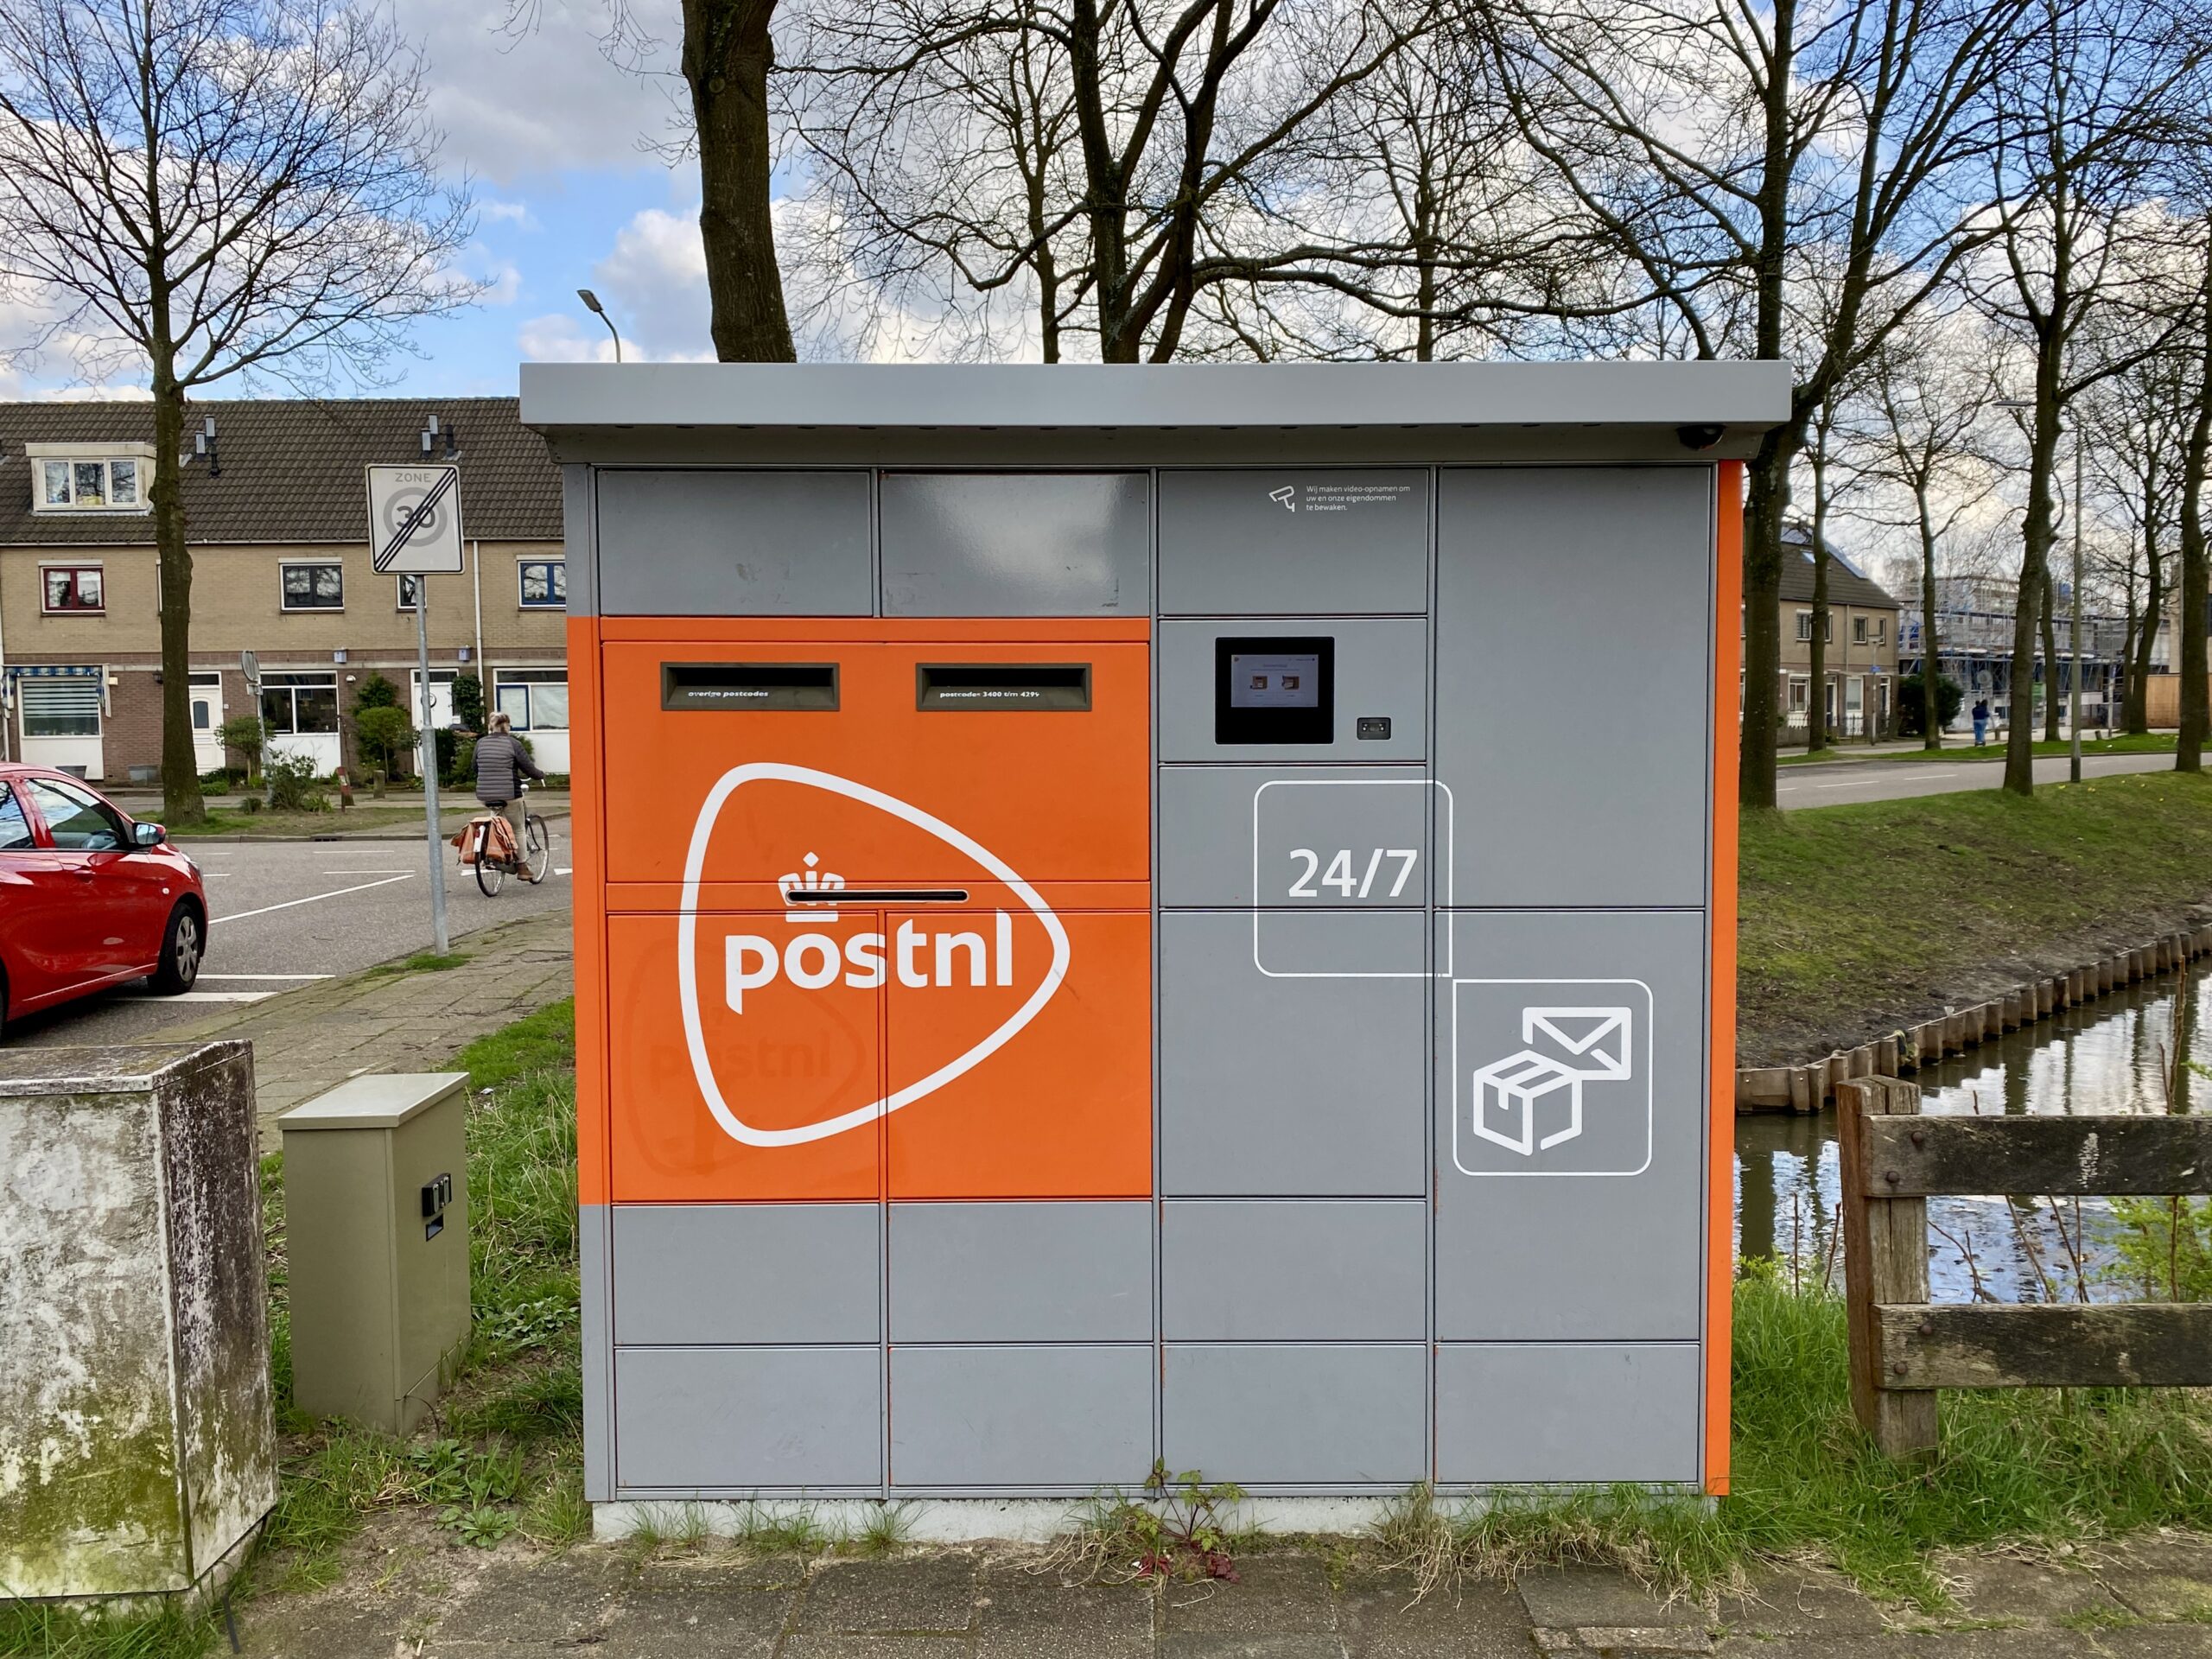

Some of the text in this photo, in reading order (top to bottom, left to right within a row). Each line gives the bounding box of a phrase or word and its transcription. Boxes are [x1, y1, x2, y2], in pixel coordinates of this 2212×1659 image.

[395, 473, 431, 483] ZONE
[1306, 486, 1318, 494] Wij
[1344, 485, 1398, 494] video-opnamen
[1345, 494, 1396, 503] eigendommen
[396, 505, 436, 528] 30
[1287, 848, 1418, 898] 24/7
[725, 906, 1013, 1015] postnl
[649, 1028, 830, 1094] pstnl
